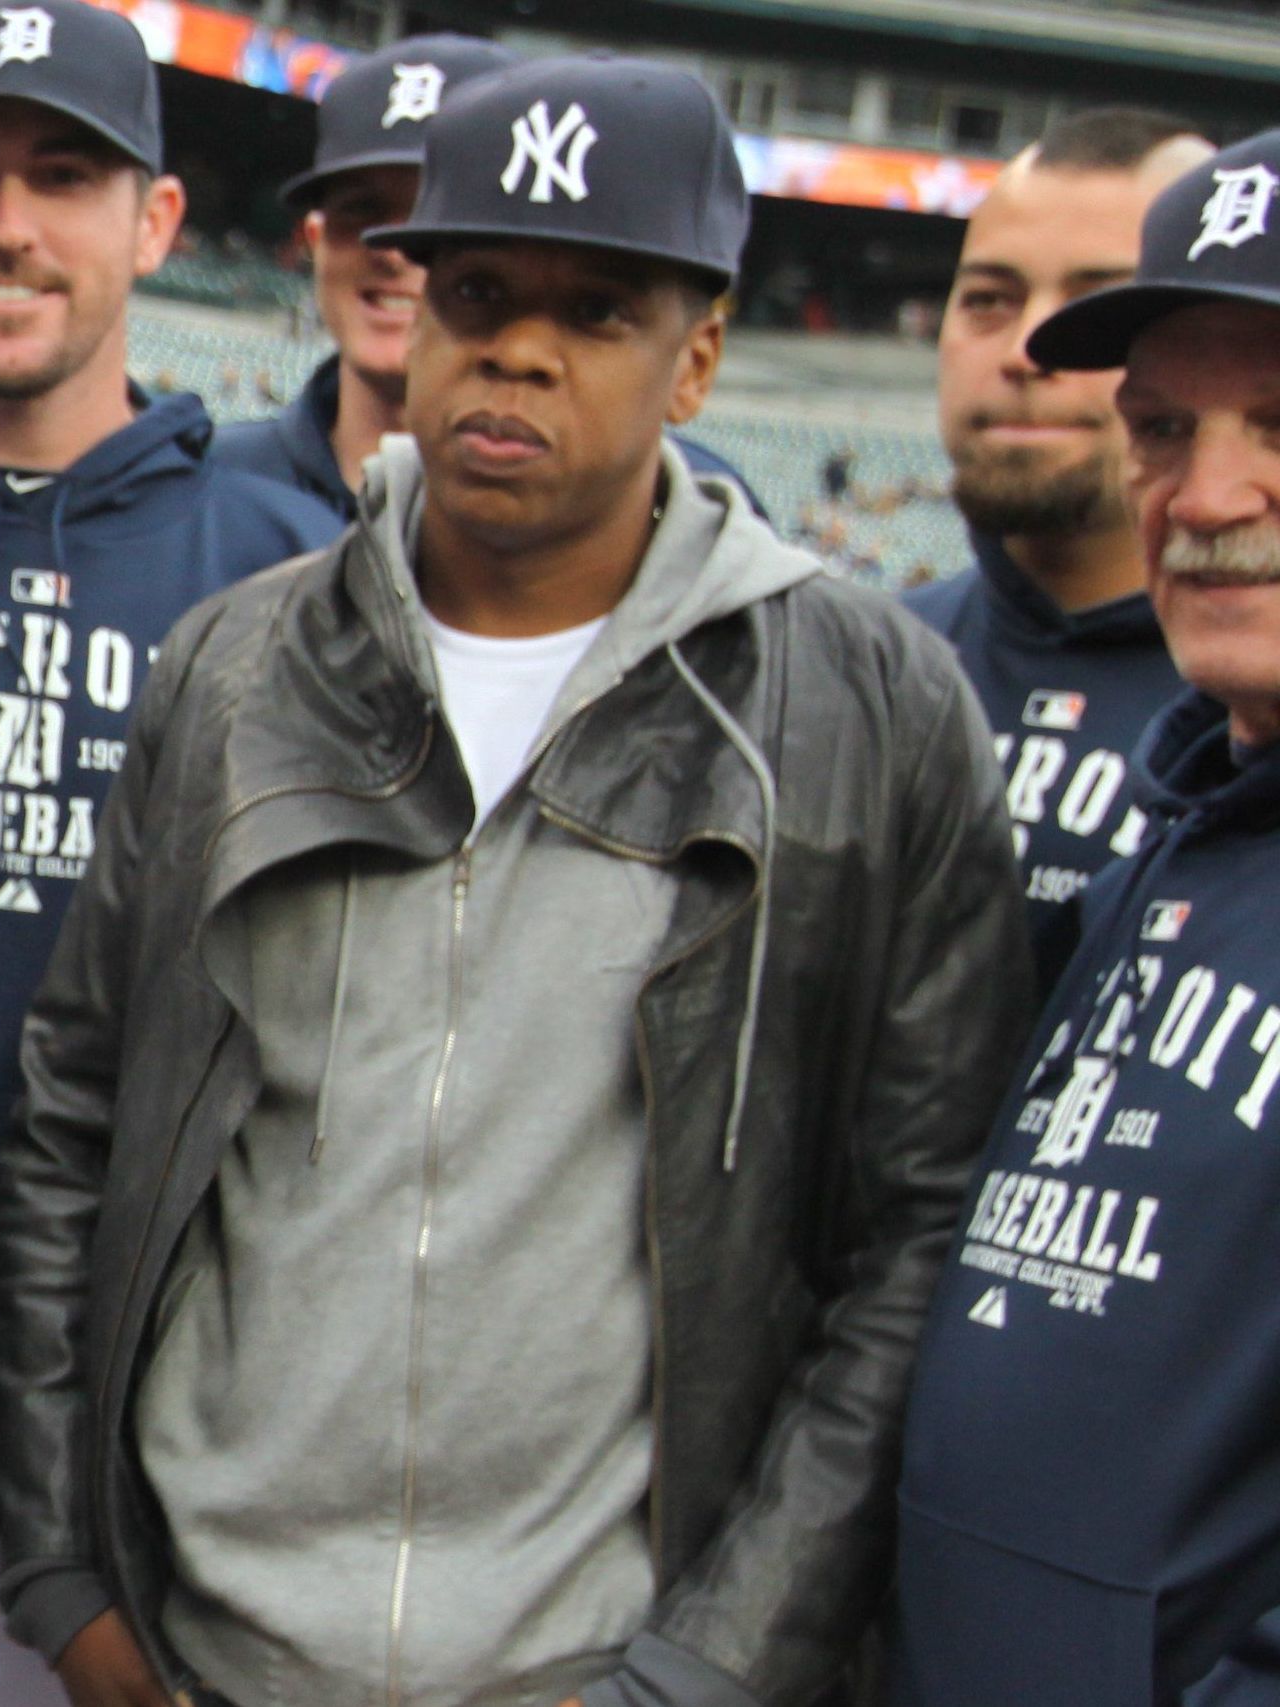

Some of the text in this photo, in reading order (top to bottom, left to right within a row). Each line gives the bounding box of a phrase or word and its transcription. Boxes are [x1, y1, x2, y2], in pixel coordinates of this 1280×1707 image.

[381, 63, 447, 129] D
[500, 99, 599, 203] NY
[1186, 163, 1280, 262] D
[76, 736, 128, 773] 190
[1104, 1109, 1161, 1149] 1901
